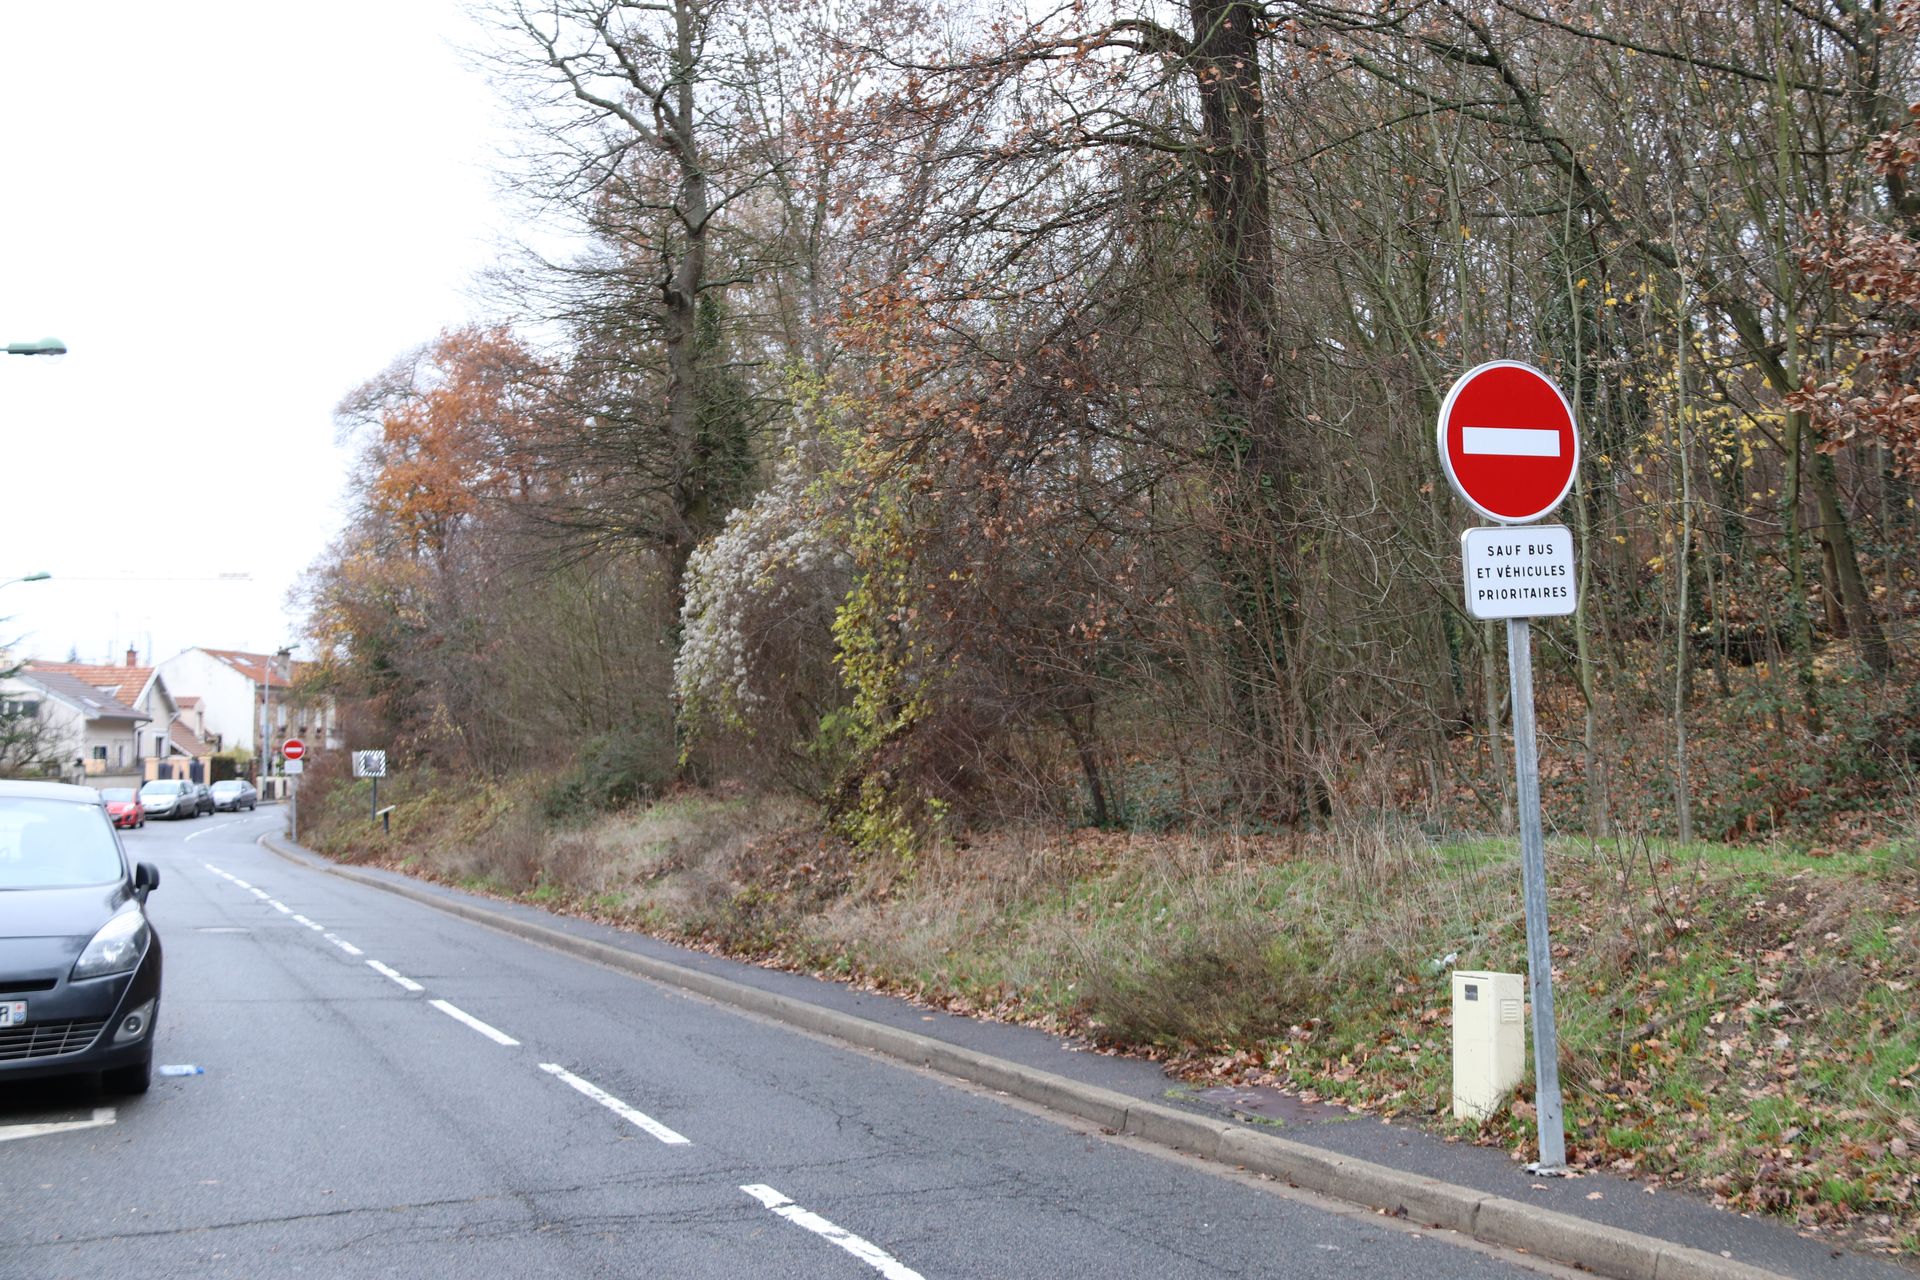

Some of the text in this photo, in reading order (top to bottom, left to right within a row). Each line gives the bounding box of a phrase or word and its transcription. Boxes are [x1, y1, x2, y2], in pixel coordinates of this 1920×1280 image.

[1487, 544, 1553, 556] SAUF BUS
[1477, 565, 1565, 578] ET VÉHICULES
[1478, 587, 1567, 600] PRIORITAIRES
